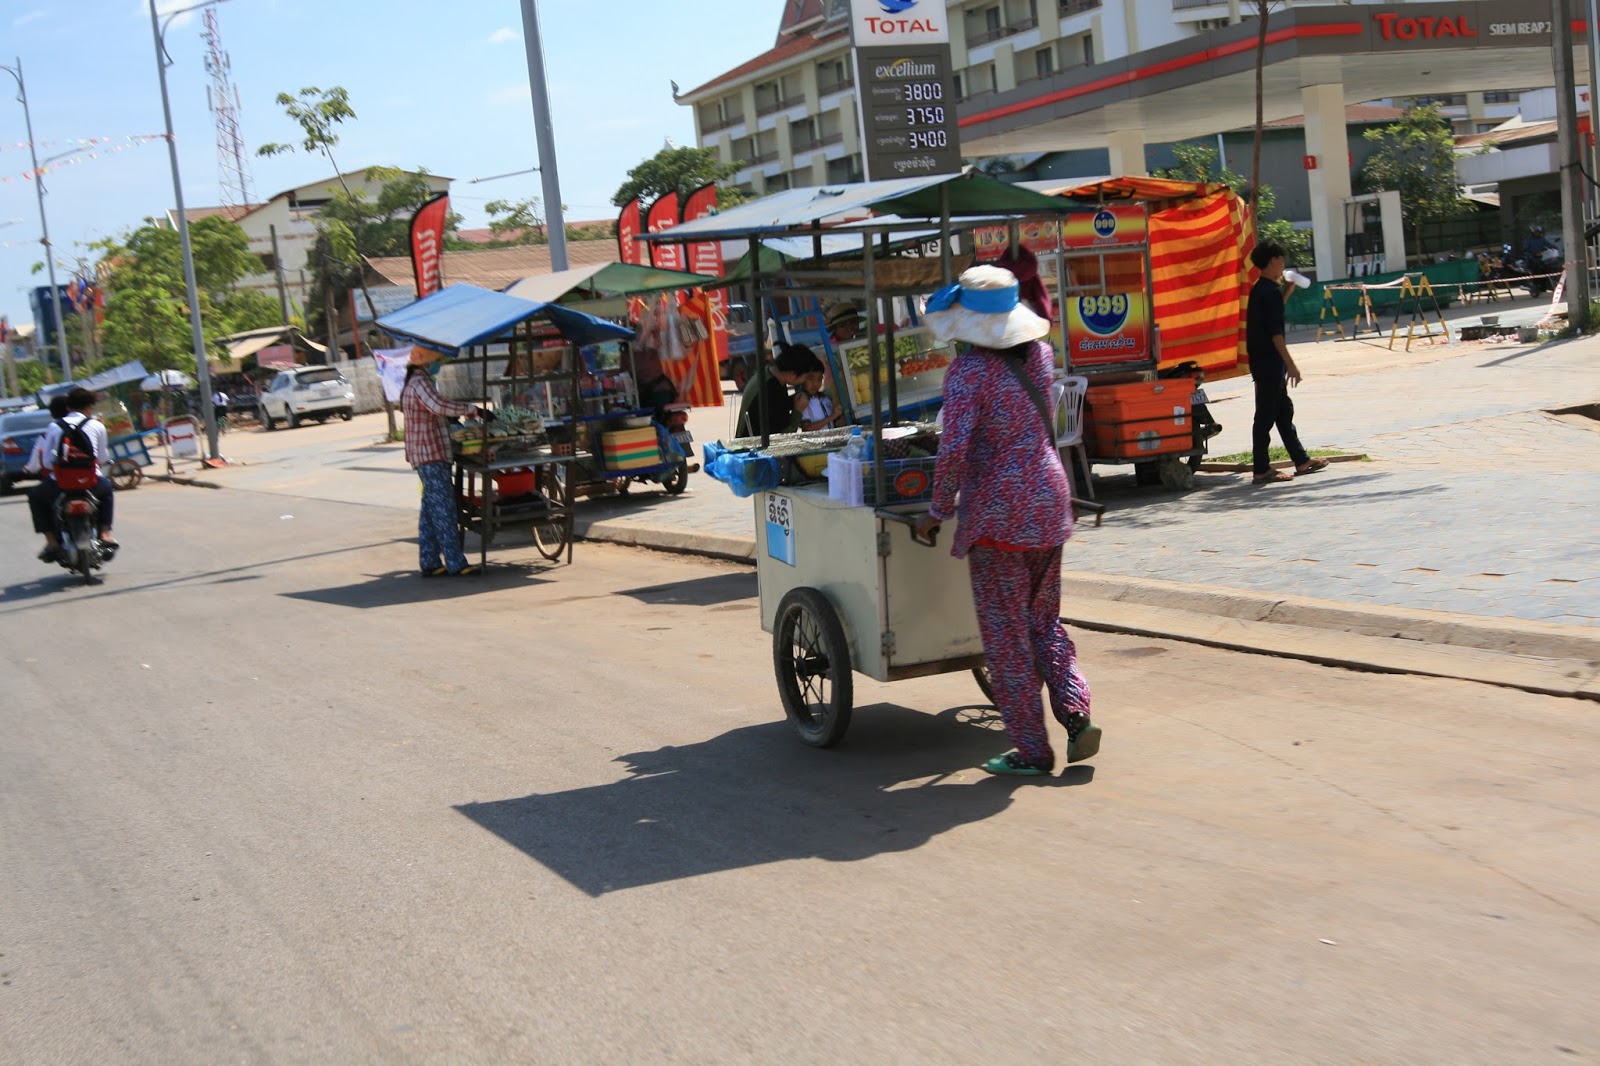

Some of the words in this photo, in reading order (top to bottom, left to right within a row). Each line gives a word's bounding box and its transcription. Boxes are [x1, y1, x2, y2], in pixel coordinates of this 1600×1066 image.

[864, 17, 939, 34] TOTAL
[1373, 13, 1478, 41] TOTAL
[1489, 23, 1517, 36] SIEM
[1517, 21, 1544, 35] REAP
[875, 60, 936, 78] excellium
[904, 83, 942, 101] 3800
[906, 106, 945, 126] 3750
[909, 130, 947, 149] 3400
[1082, 294, 1126, 317] 999
